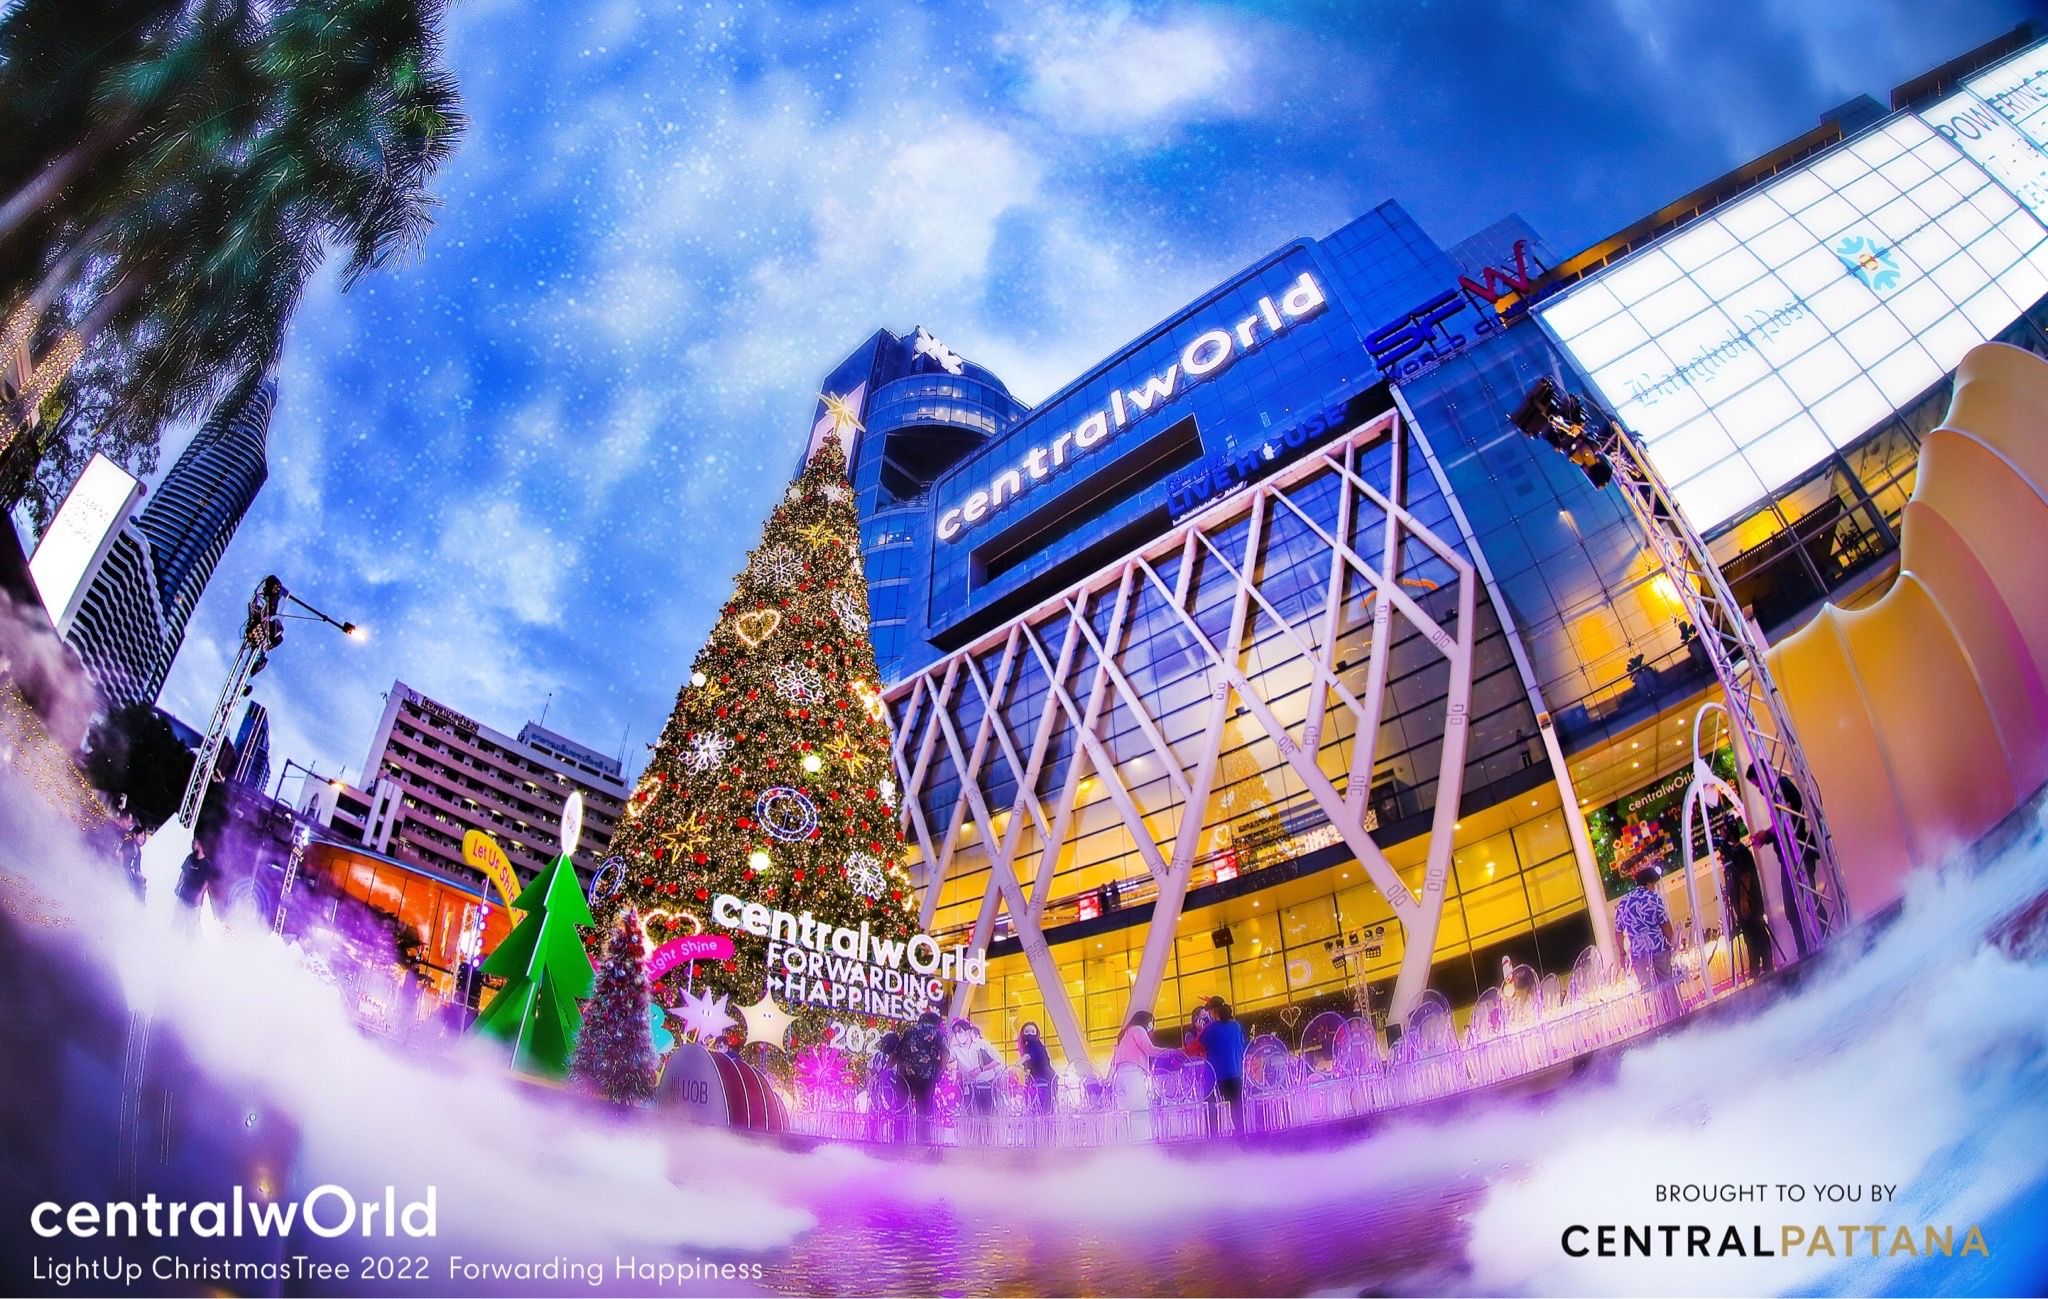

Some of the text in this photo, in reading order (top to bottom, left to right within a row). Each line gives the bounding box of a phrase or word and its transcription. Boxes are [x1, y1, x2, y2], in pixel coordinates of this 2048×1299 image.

[936, 272, 1326, 542] centralwOrld
[1167, 468, 1233, 517] LIVE
[473, 838, 487, 858] Let
[488, 848, 500, 870] Us
[647, 940, 717, 974] Light Shine
[713, 894, 986, 985] centralwOrld
[766, 943, 944, 1001] FORWARDING
[784, 974, 928, 1021] HAPPINESS
[829, 1020, 895, 1053] 202
[681, 1079, 708, 1105] UOB
